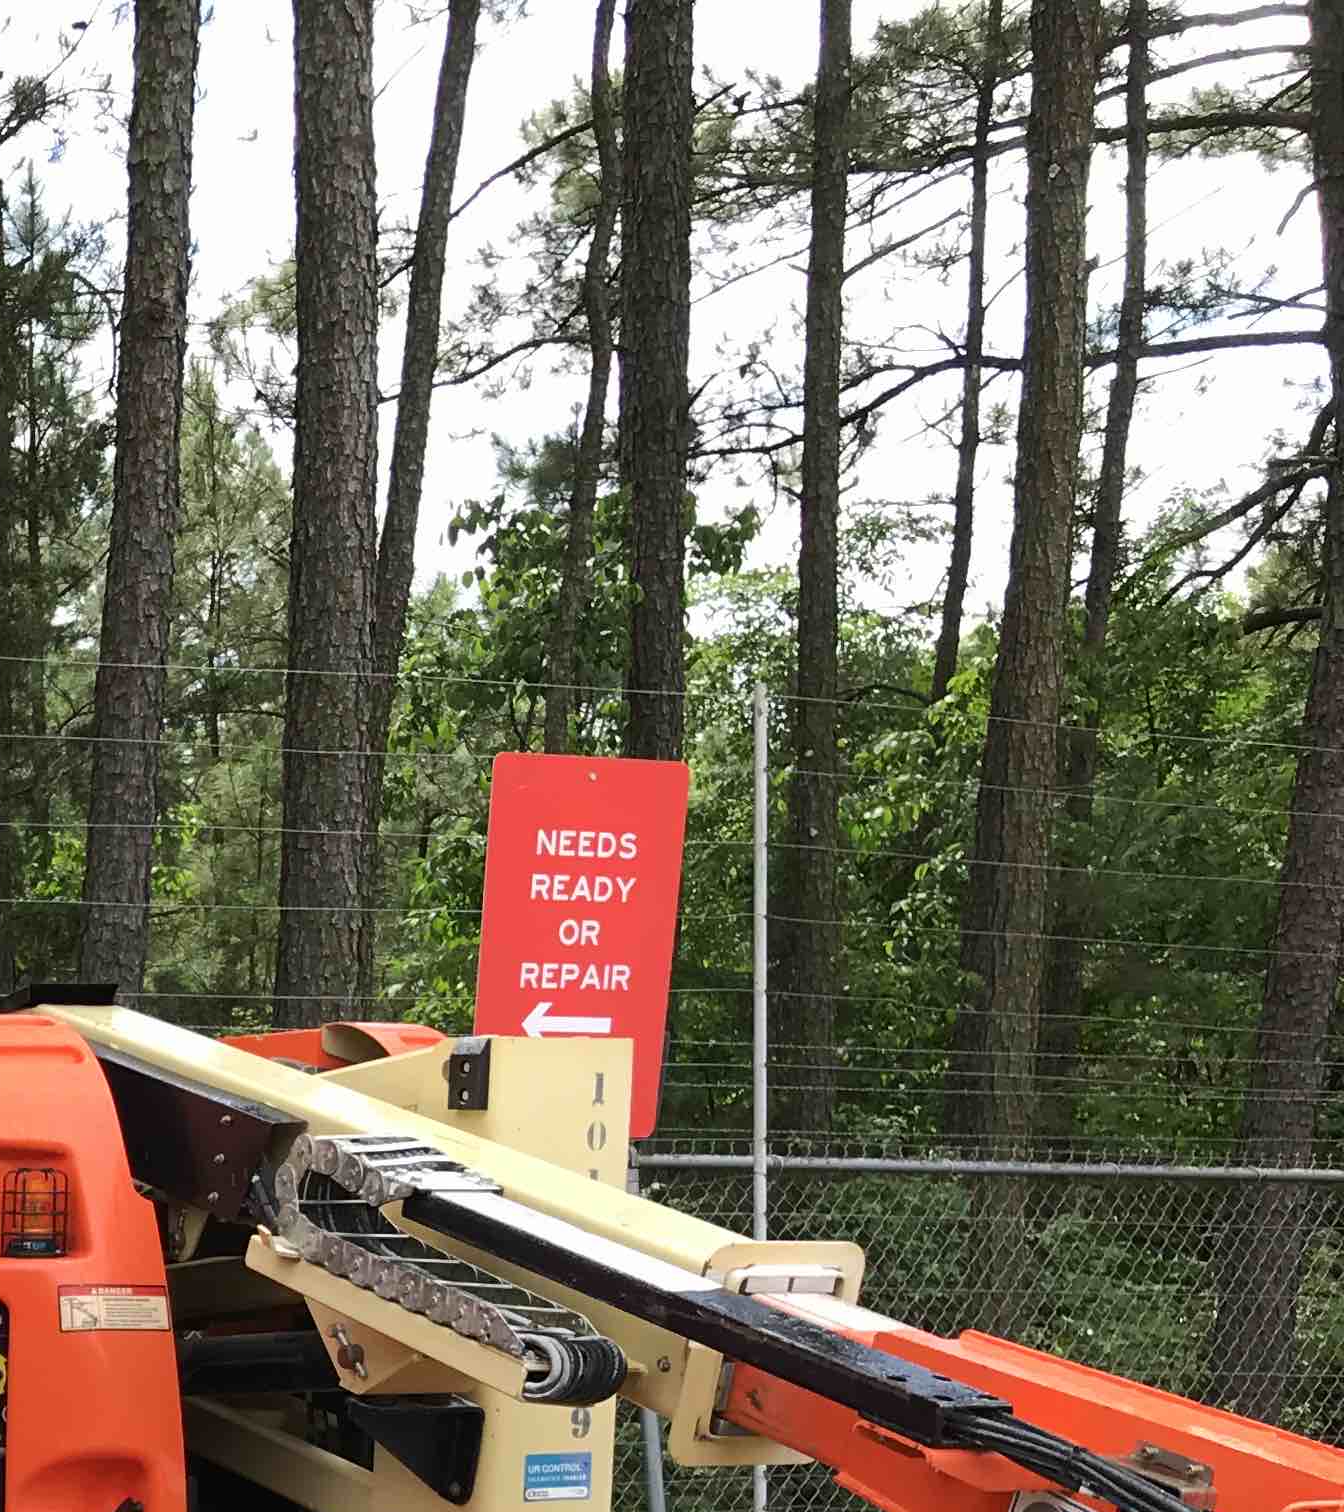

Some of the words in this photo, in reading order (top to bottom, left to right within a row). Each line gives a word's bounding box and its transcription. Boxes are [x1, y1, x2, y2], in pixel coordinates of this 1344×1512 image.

[535, 829, 639, 860] NEEDS
[529, 873, 638, 904] READY
[558, 919, 602, 946] OR
[519, 961, 632, 992] REPAIR
[542, 1463, 581, 1473] CONTROL
